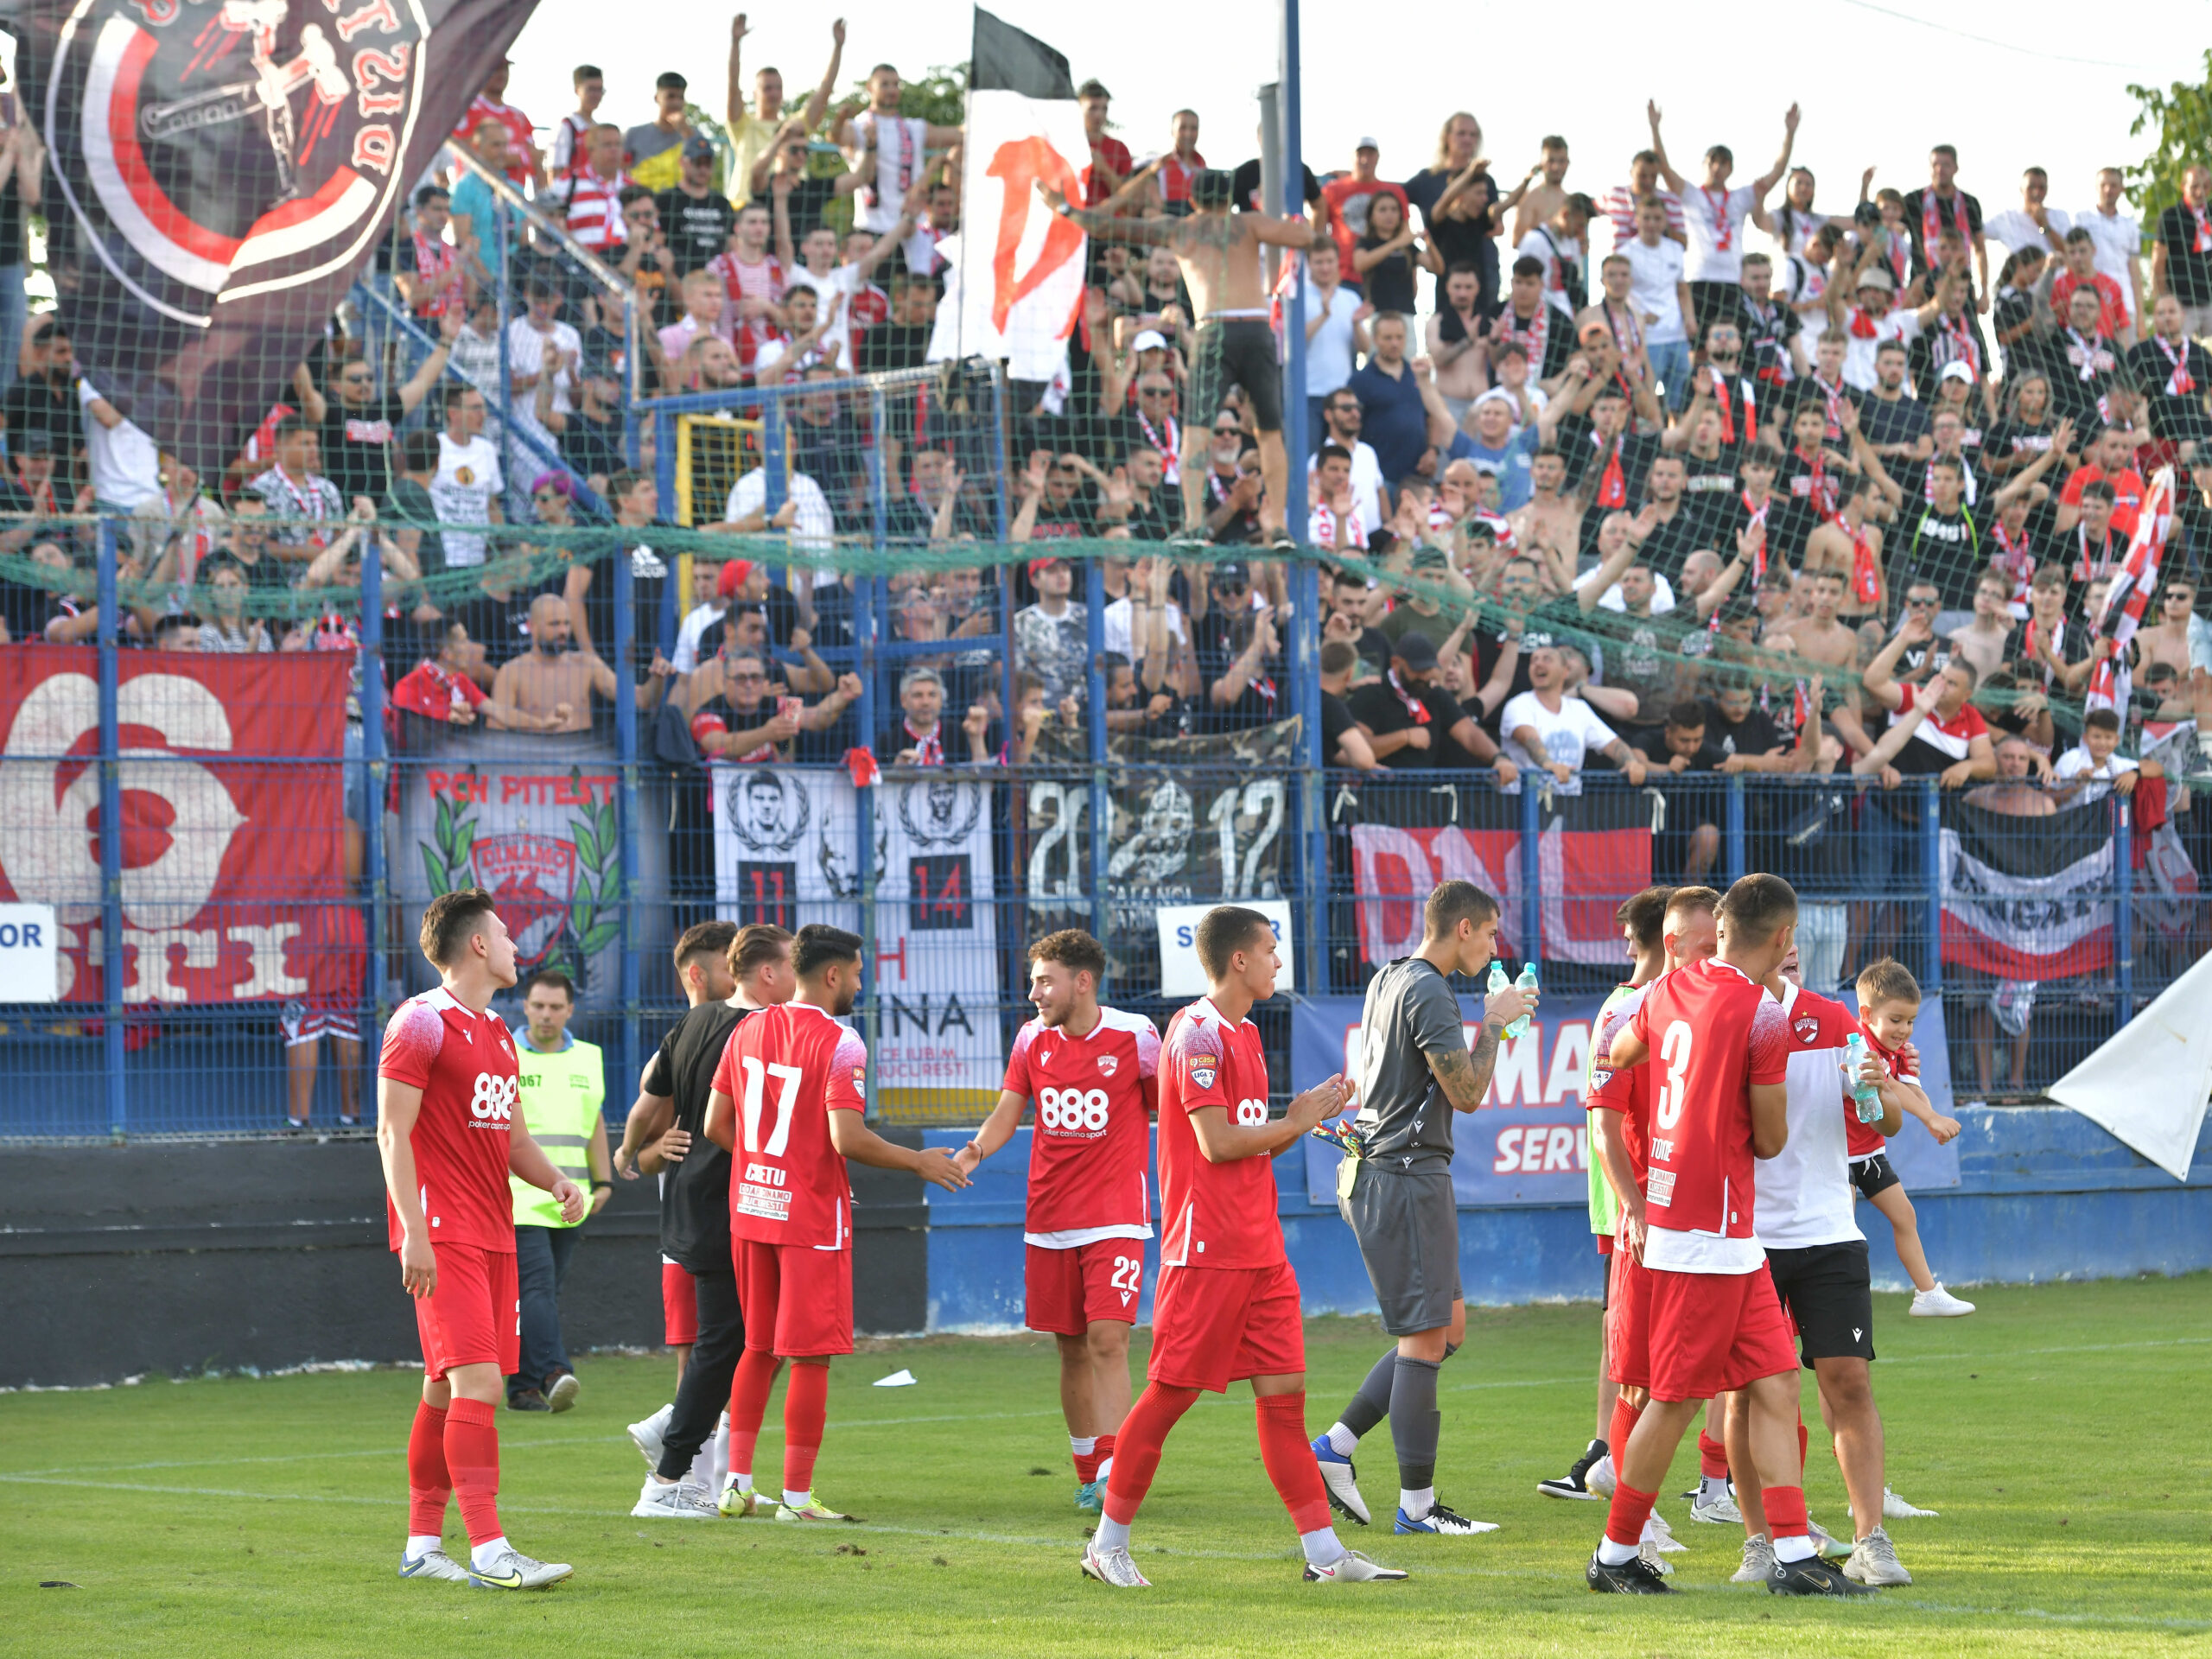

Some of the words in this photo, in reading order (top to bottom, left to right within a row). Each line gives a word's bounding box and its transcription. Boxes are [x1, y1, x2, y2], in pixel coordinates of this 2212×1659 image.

[481, 843, 567, 868] DINAMO
[750, 871, 785, 927] 11
[915, 863, 966, 920] 14
[470, 1071, 518, 1121] 888
[1656, 1020, 1693, 1130] 3
[741, 1056, 803, 1158] 17
[1039, 1087, 1109, 1131] 888
[1085, 1128, 1108, 1140] sport
[1110, 1255, 1141, 1294] 22
